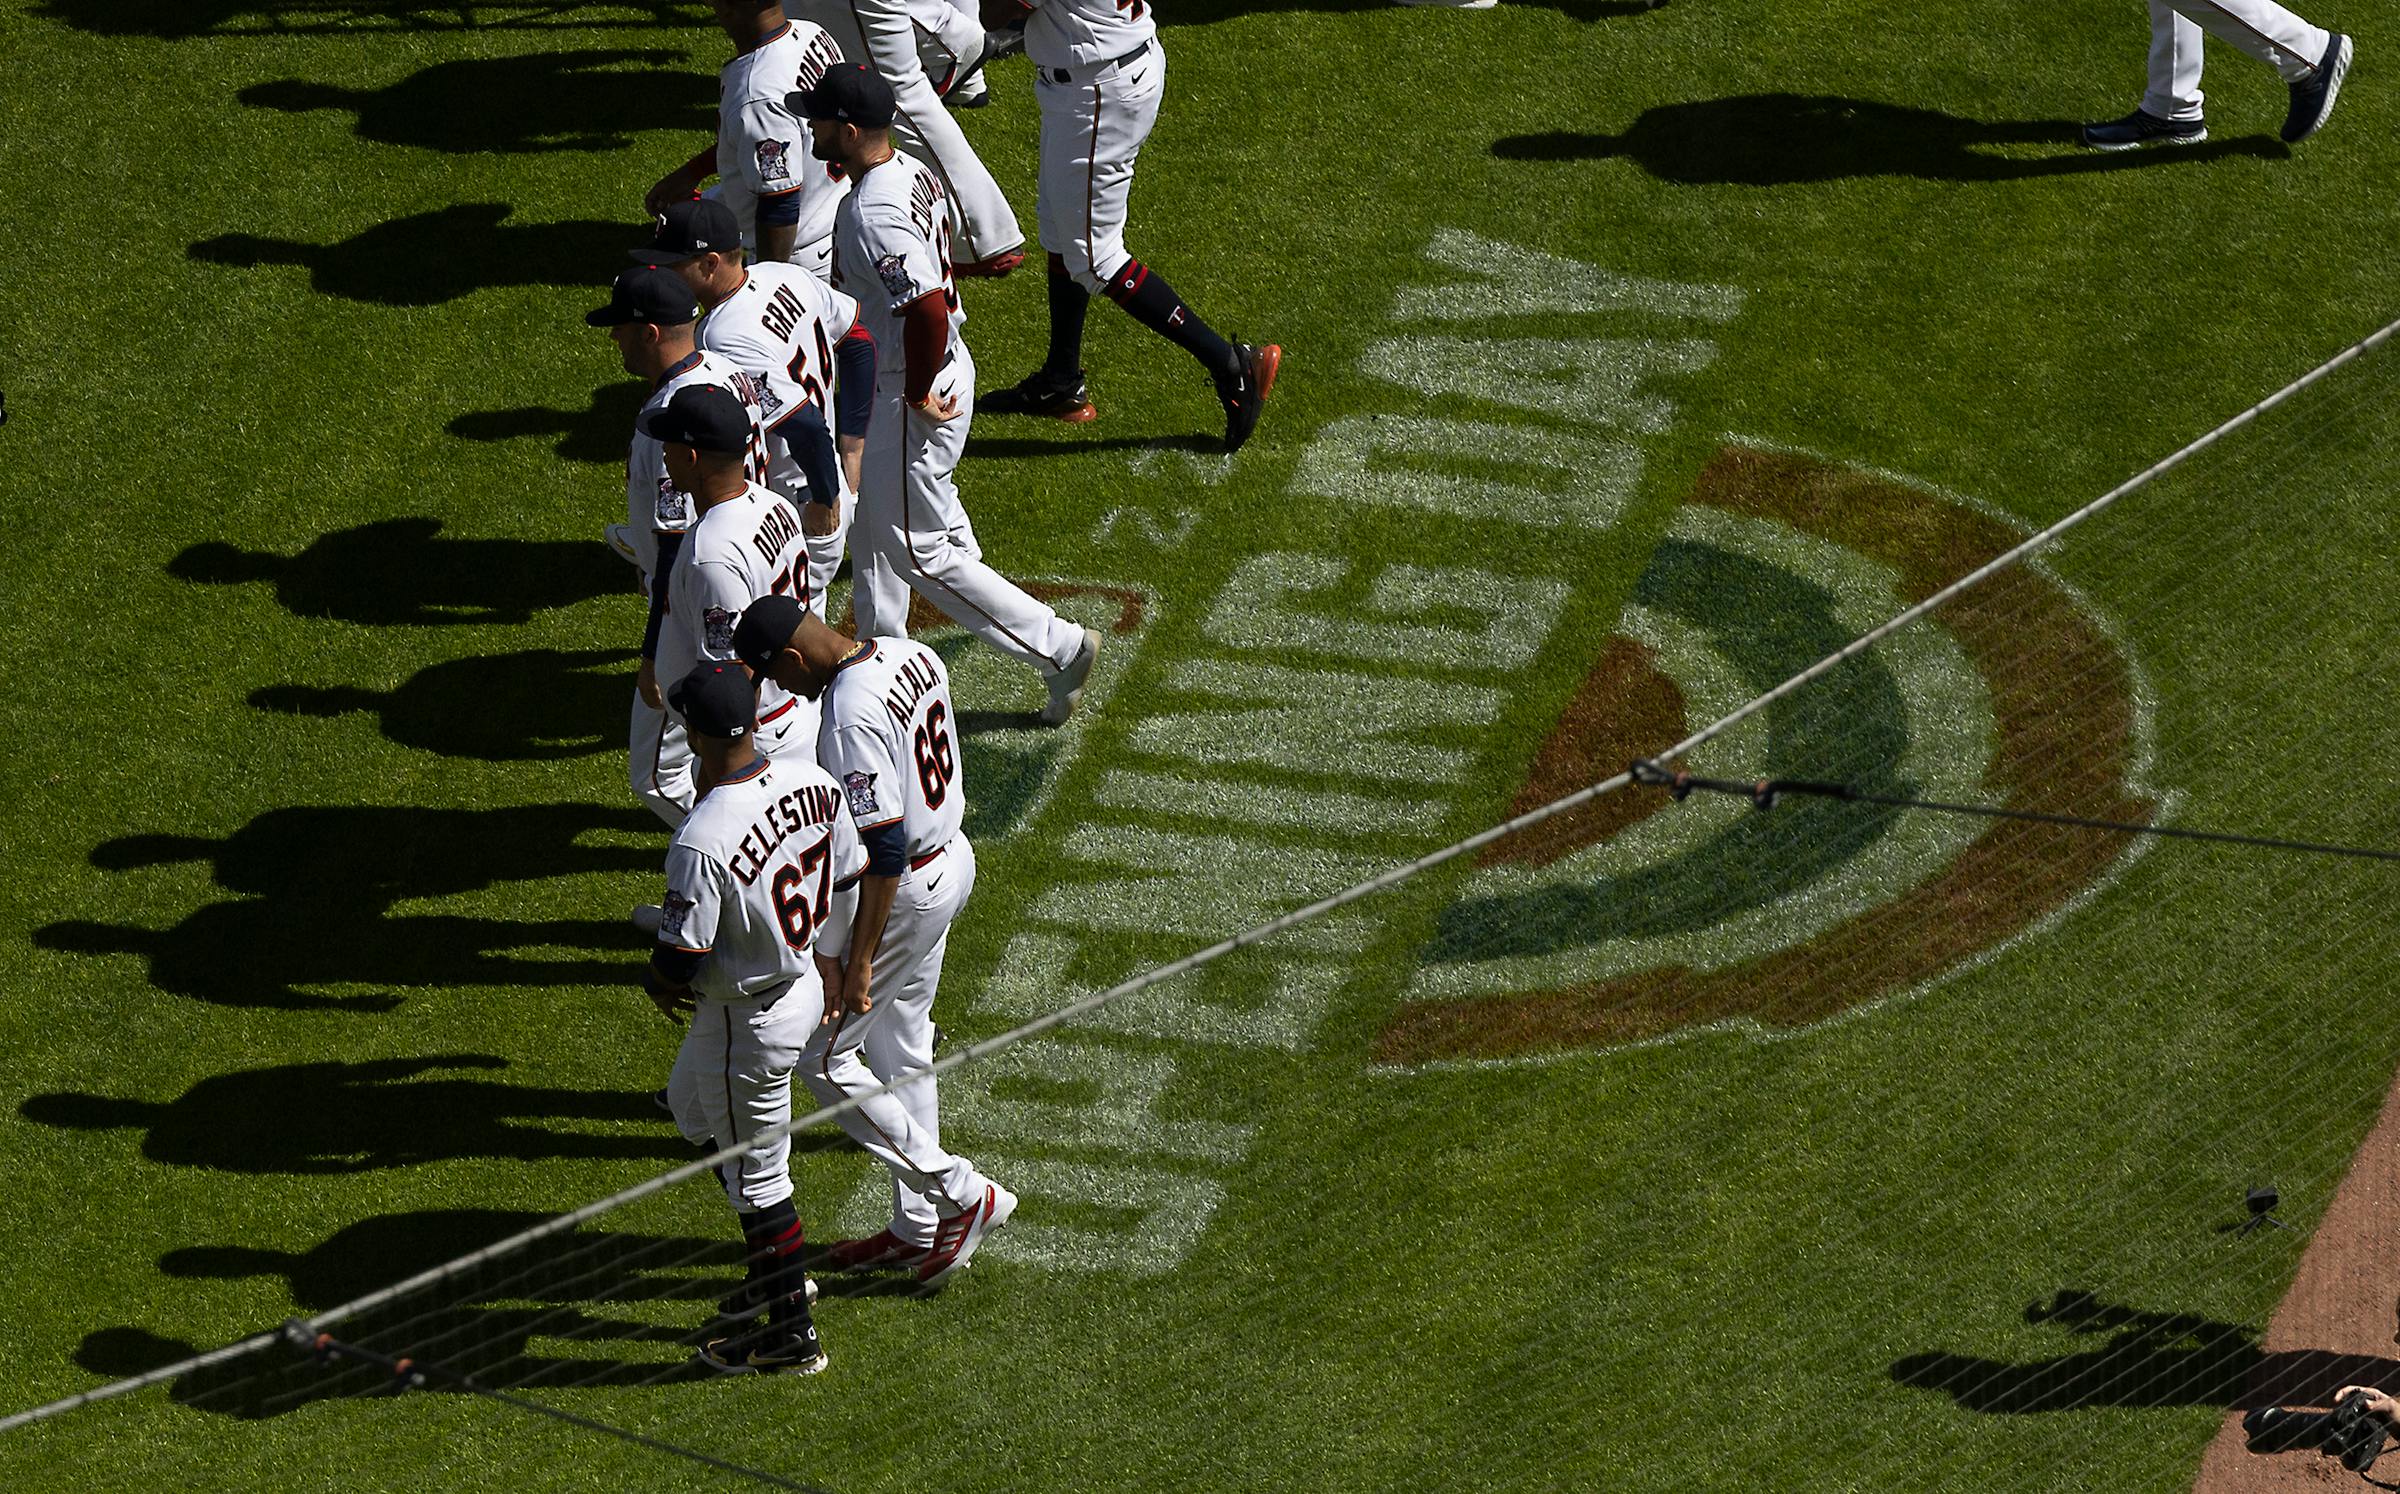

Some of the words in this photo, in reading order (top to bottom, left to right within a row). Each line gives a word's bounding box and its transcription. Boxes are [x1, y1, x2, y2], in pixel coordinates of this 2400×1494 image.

[761, 283, 806, 344] GRAY
[787, 316, 833, 417] 54
[752, 502, 801, 570] DURAN
[886, 651, 941, 732] ALCALA
[840, 550, 1575, 1276] OPENING
[1288, 226, 1746, 530] DAY
[913, 698, 954, 812] 66
[728, 784, 843, 888] CELESTINO
[771, 829, 833, 952] 67
